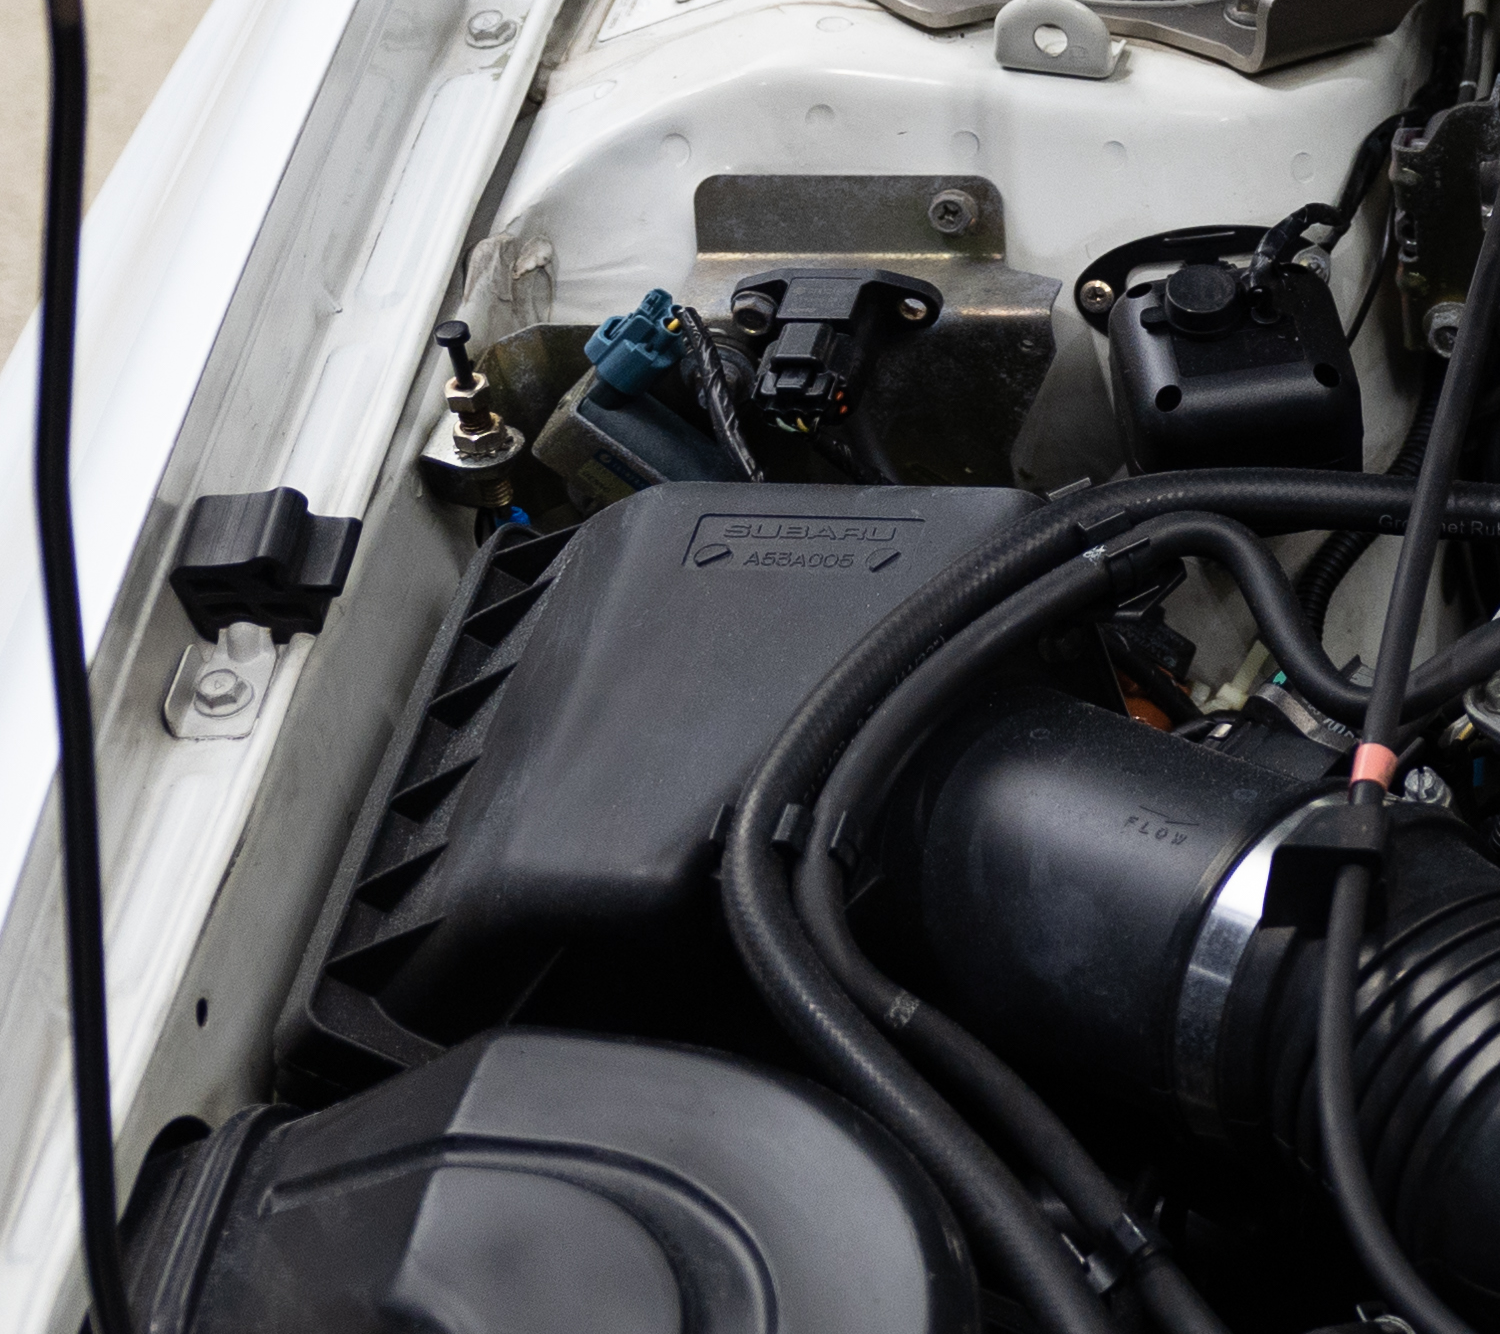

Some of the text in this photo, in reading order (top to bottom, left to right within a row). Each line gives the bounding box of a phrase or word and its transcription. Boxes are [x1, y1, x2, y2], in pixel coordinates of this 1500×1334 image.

[723, 522, 901, 542] SUBARU
[742, 550, 856, 569] A53A005
[1121, 816, 1189, 846] FLOW
